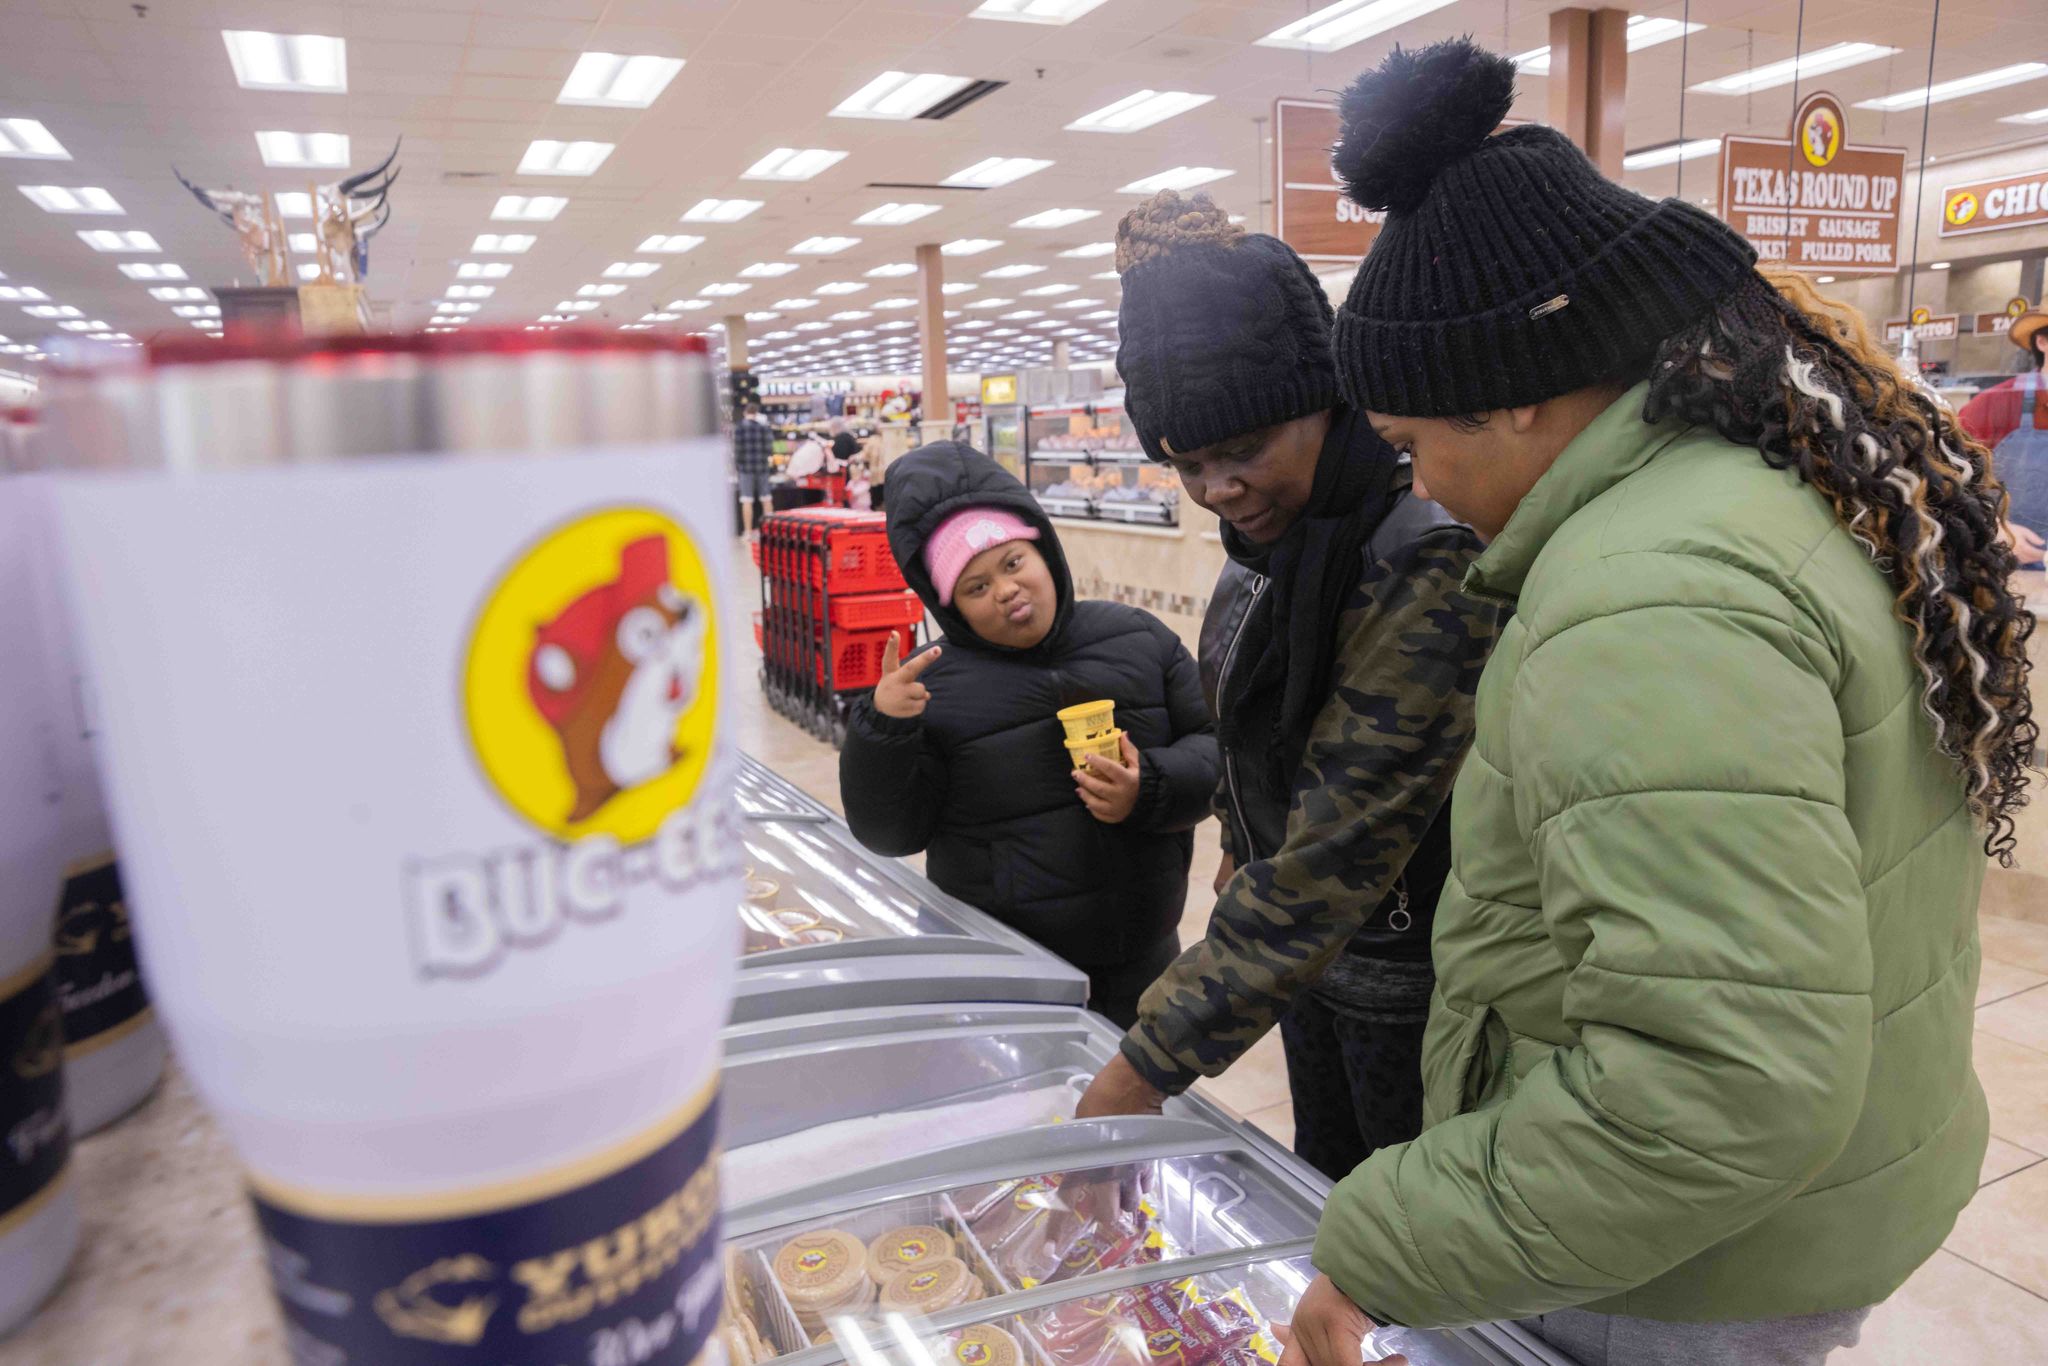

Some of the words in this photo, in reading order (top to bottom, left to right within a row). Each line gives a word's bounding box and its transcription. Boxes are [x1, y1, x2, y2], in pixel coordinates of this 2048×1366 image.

[1733, 167, 1799, 206] TEXAS
[1801, 171, 1868, 210] ROUND
[1871, 175, 1897, 211] UP
[1747, 215, 1808, 237] BRISKET
[1818, 218, 1880, 239] SAUSAGE
[1801, 241, 1853, 261] PULLED
[1855, 243, 1892, 262] PORK
